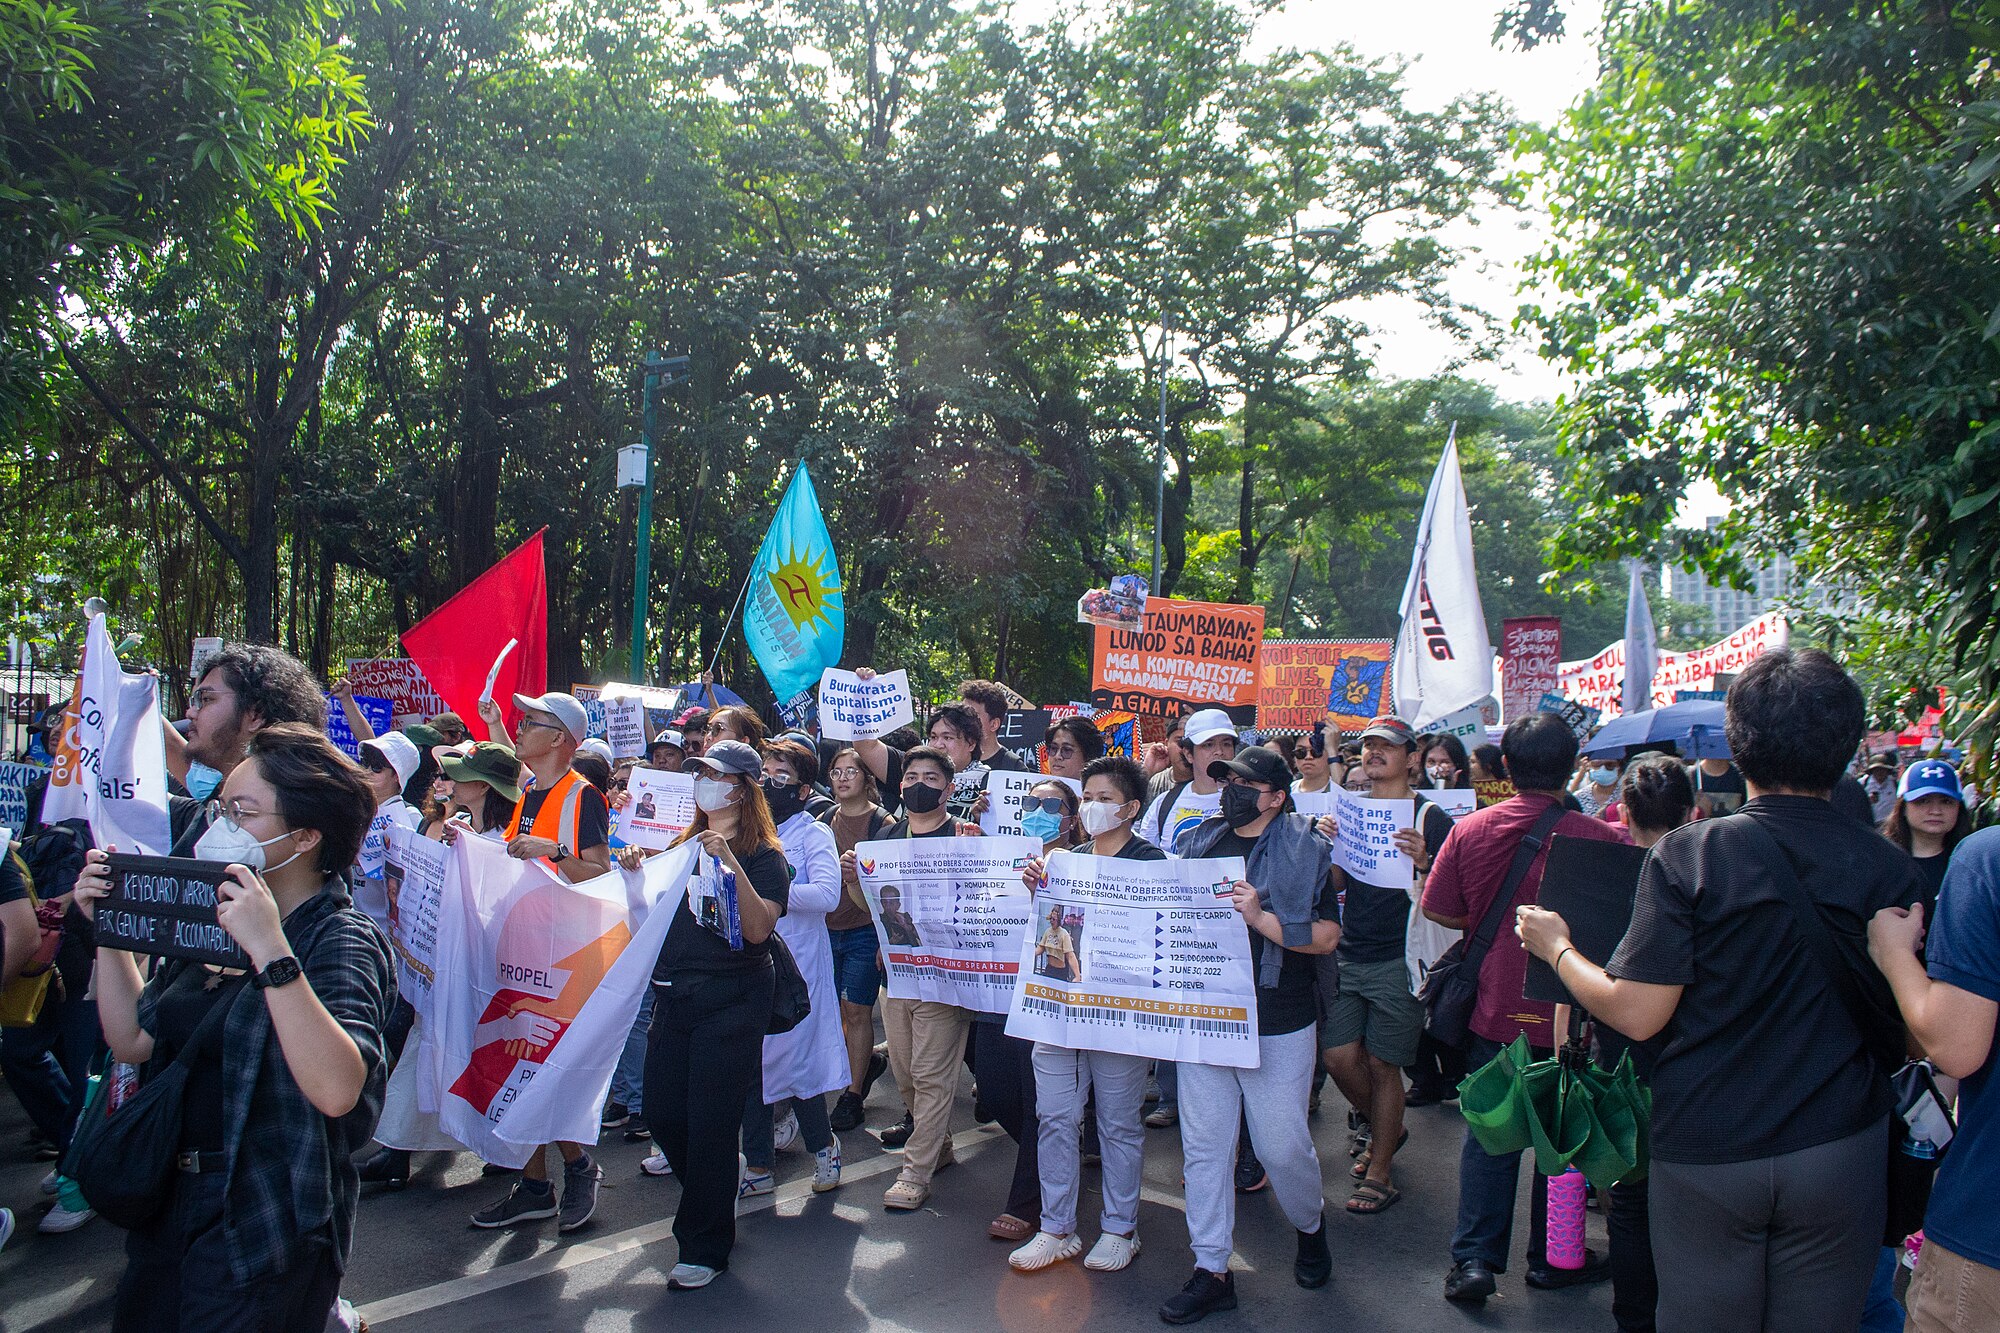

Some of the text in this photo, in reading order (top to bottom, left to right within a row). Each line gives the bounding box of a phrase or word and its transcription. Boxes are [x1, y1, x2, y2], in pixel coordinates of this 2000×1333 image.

[1144, 612, 1257, 642] TAUMBAYAN:
[1110, 630, 1257, 664] LUNOD SA BAHA!
[1261, 646, 1342, 666] YOU STOLE
[1106, 653, 1254, 685] MGA KONTRATISTA:
[1276, 666, 1325, 687] LIVES,
[829, 679, 897, 695] Burukrata
[1103, 670, 1175, 691] UMAAPAW
[1188, 680, 1238, 702] PERA!
[1578, 672, 1616, 695] PARA
[822, 692, 907, 709] kapitalismo,
[1261, 688, 1333, 706] NOT JUST
[1111, 695, 1180, 718] AGHAM
[833, 707, 897, 727] ibagsak!
[1005, 778, 1032, 791] Lah
[1367, 809, 1392, 822] ang
[1340, 820, 1389, 845] kurakot na
[1354, 818, 1364, 831] ng
[1367, 822, 1396, 834] mga
[1384, 848, 1399, 859] at
[880, 860, 931, 870] PROFESSIONAL
[933, 860, 962, 868] ROBBERS
[1051, 877, 1121, 892] PROFESSIONAL
[1125, 885, 1168, 895] ROBBERS
[1097, 873, 1128, 883] Republic
[1139, 877, 1150, 885] the
[124, 872, 179, 905] KEYBOARD
[1070, 888, 1128, 901] PROFESSIONAL
[1130, 894, 1182, 902] IDENTIFICATION
[99, 909, 115, 933] FOR
[116, 911, 157, 942] GENUINE
[992, 929, 1009, 937] 2019
[1170, 926, 1193, 934] SARA
[905, 955, 929, 963] BLOD
[1120, 952, 1148, 960] AMOUNT
[1091, 961, 1134, 971] REGISTRATION
[1168, 965, 1191, 974] JUNE
[1203, 967, 1222, 976] 2022
[500, 962, 553, 988] PROPEL
[1090, 975, 1110, 983] VALID
[1168, 980, 1205, 989] FOREVER
[1032, 985, 1233, 1016] SQUANDERING VICE PRESIDENT
[1021, 1008, 1059, 1020] MARCOS
[1065, 1018, 1124, 1028] SINGILIN
[1135, 1024, 1183, 1035] DUTERTE
